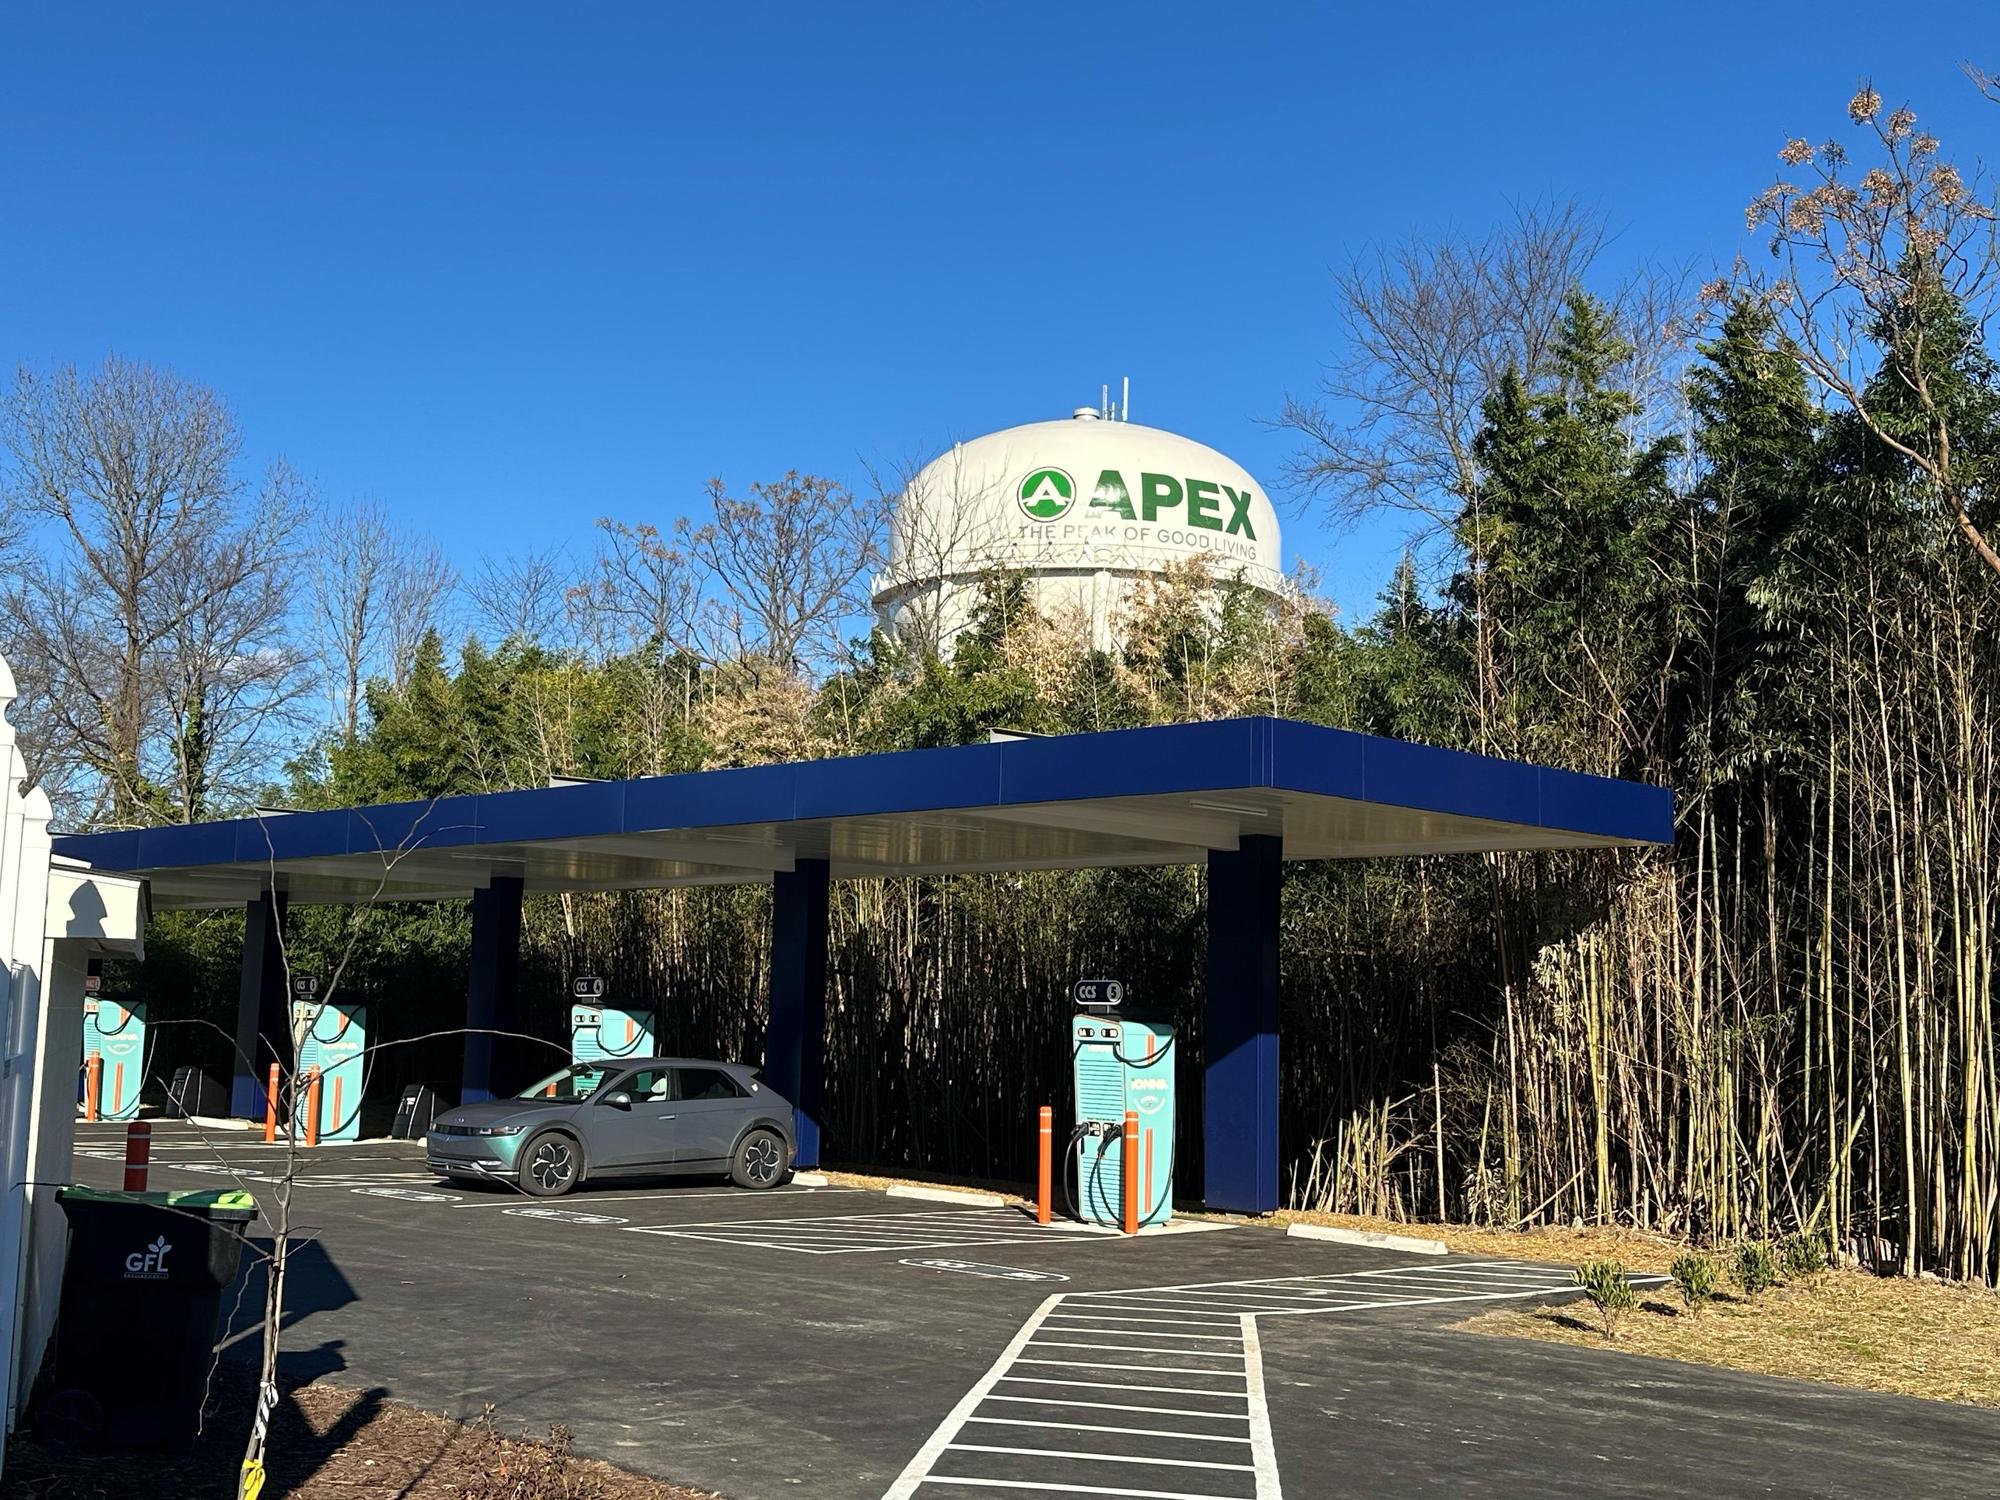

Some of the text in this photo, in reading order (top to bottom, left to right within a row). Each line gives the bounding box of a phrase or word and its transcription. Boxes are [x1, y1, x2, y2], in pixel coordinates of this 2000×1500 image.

[1085, 470, 1257, 541] APEX
[1019, 525, 1257, 560] THE PEAK OF GOOD LIVING
[1079, 985, 1097, 999] CCS
[126, 1246, 170, 1272] GFL
